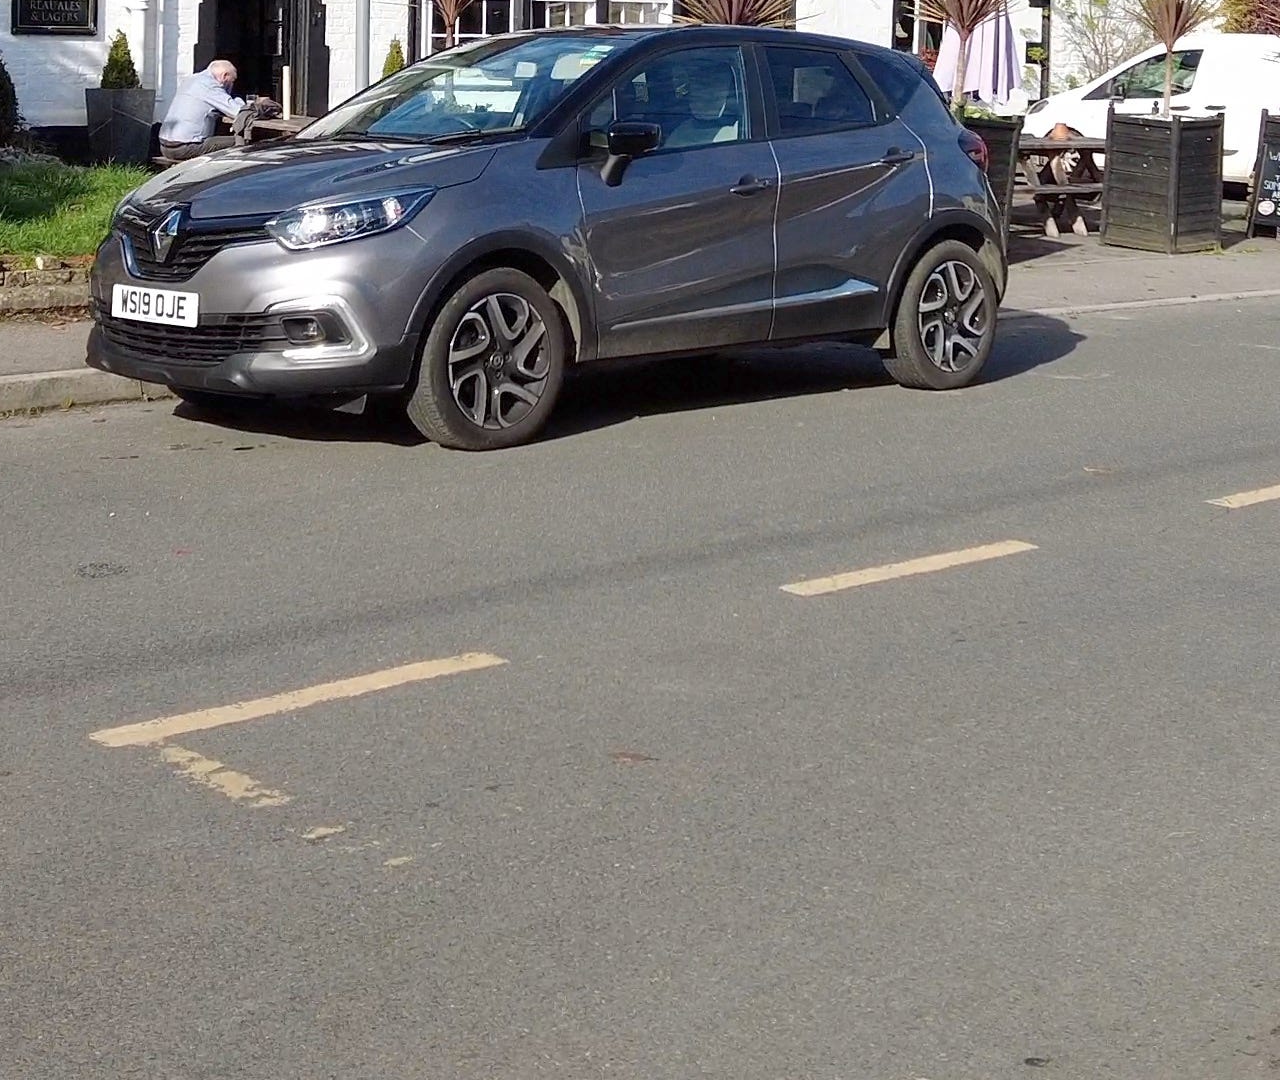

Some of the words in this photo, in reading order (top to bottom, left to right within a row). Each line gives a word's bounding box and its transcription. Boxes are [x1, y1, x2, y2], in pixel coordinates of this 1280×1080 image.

[30, 0, 56, 10] REAL
[57, 1, 81, 11] ALES
[31, 11, 40, 22] &
[41, 12, 79, 22] LAGERS
[121, 289, 151, 315] WS19
[155, 294, 187, 320] OJE
